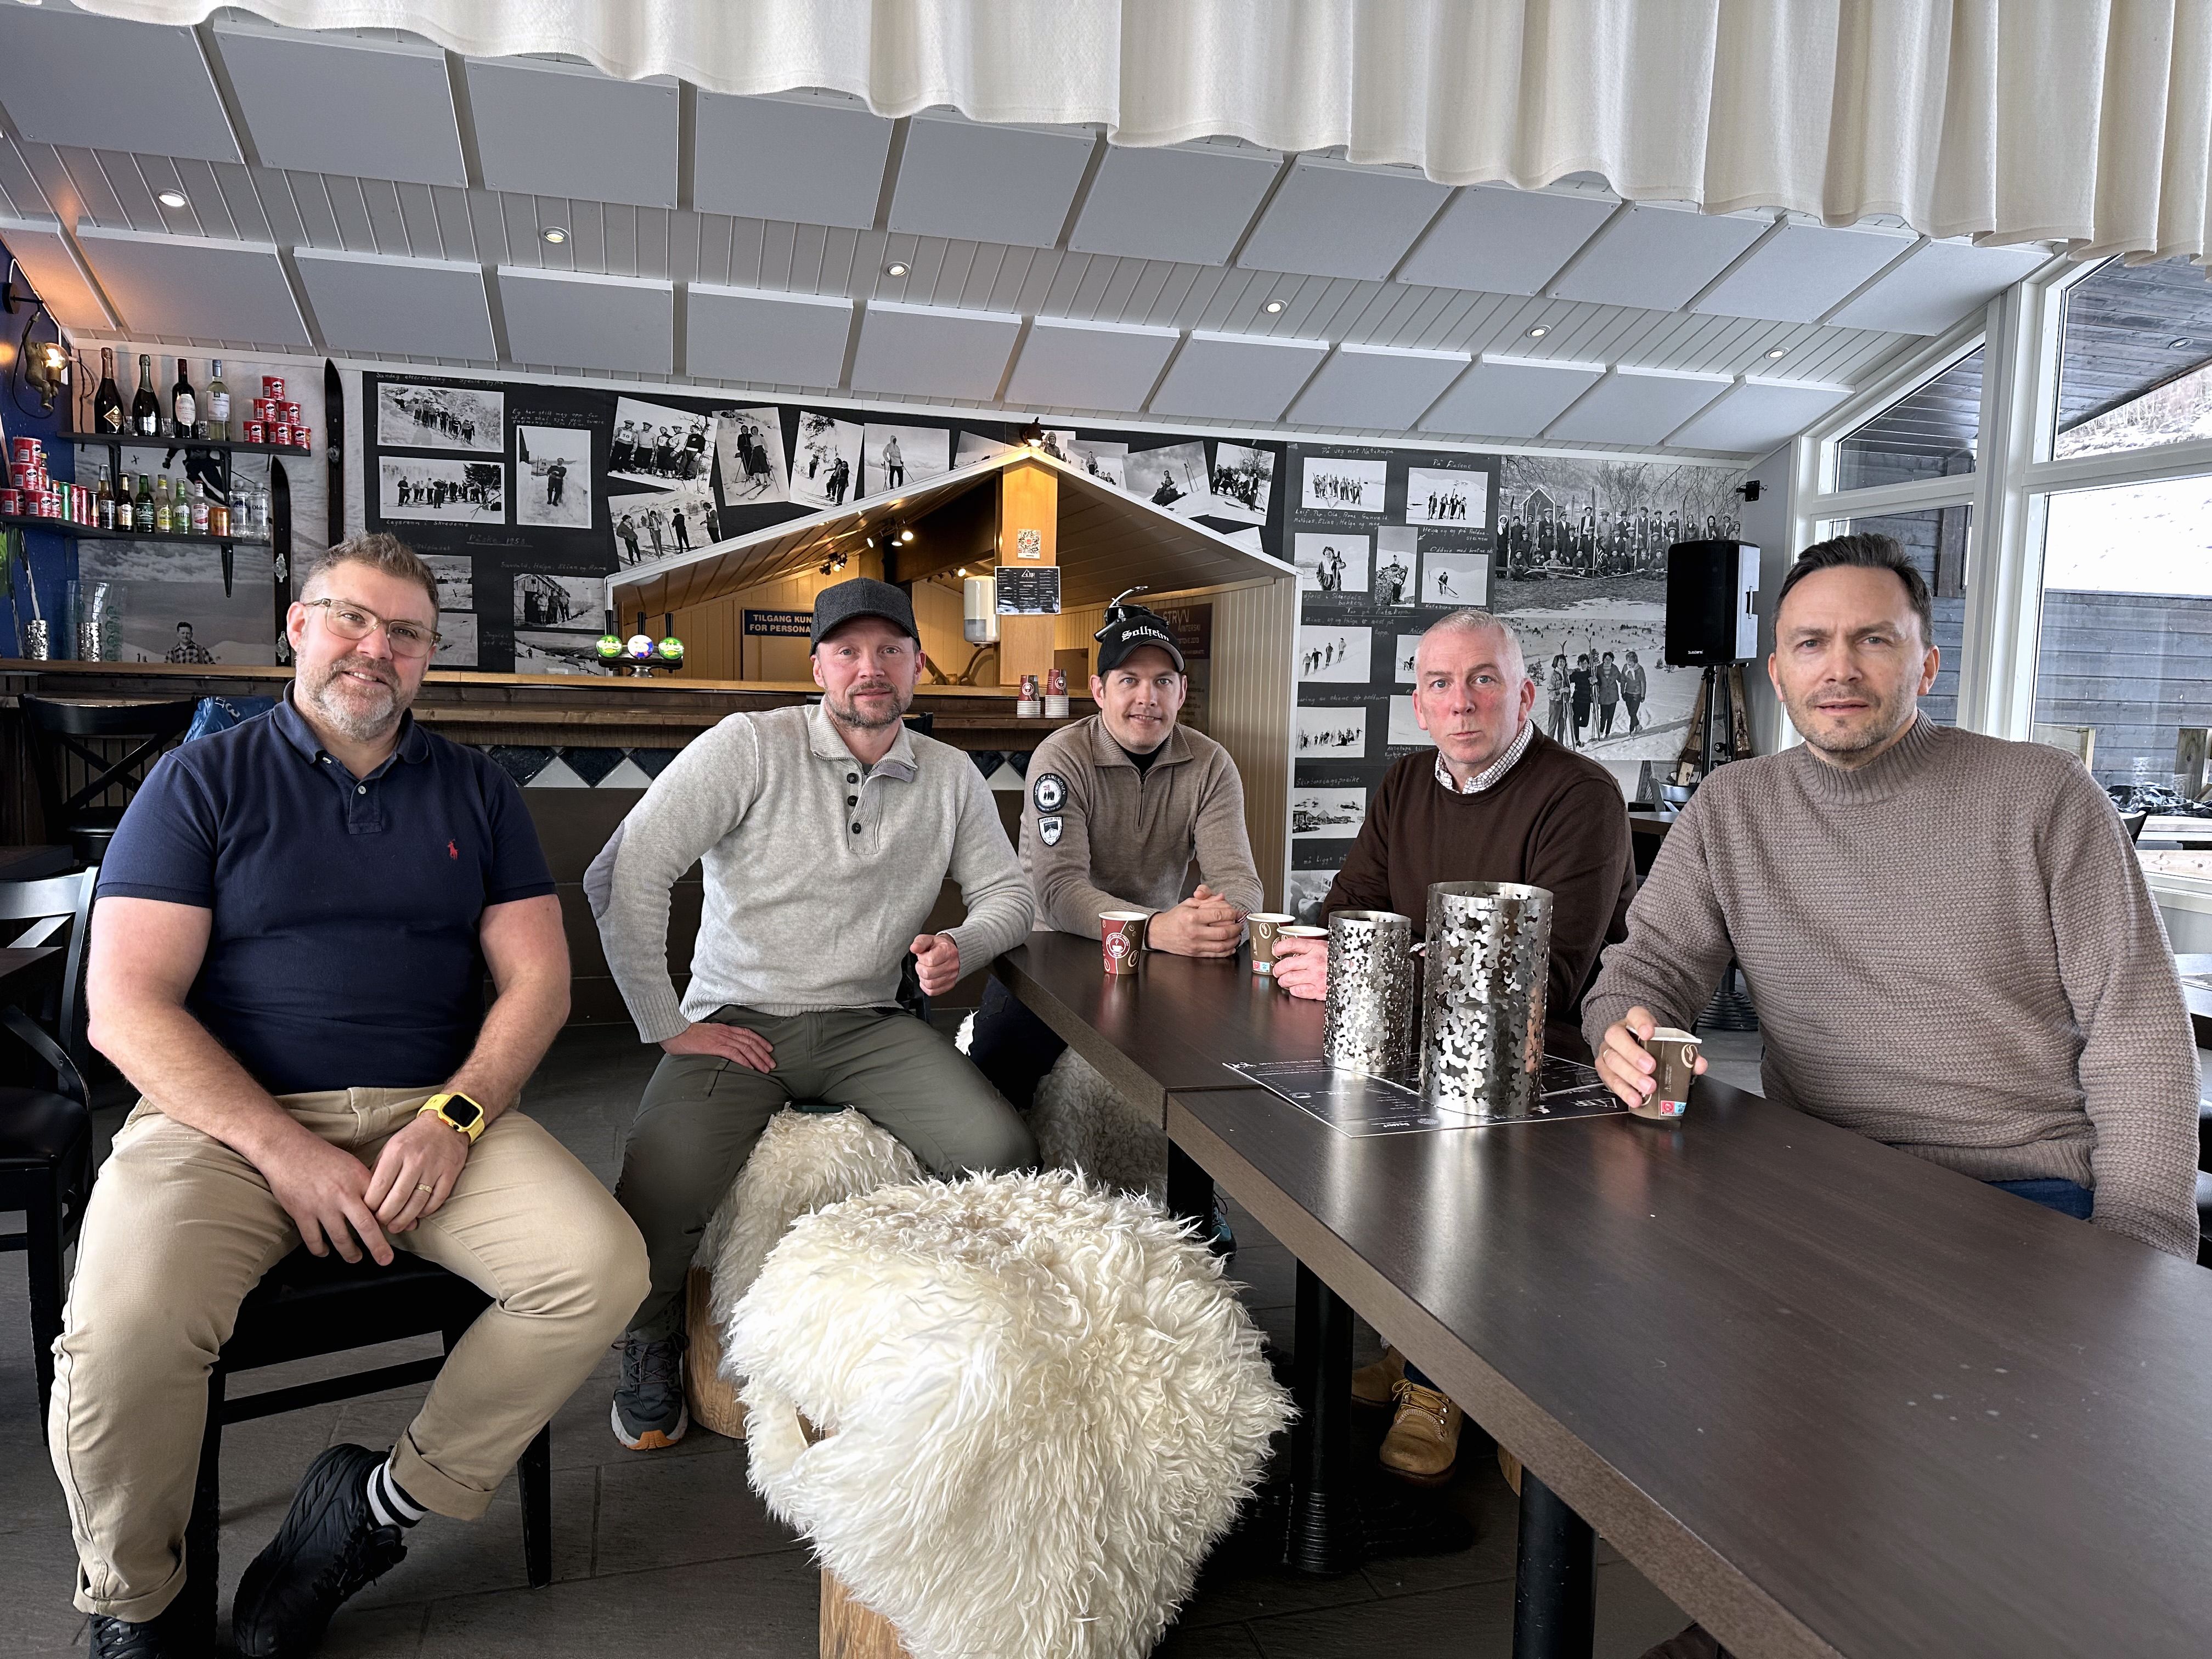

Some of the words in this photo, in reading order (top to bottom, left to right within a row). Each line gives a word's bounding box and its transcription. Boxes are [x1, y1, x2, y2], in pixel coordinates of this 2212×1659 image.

[1334, 448, 1344, 456] veg
[753, 614, 792, 623] TILGANG
[770, 624, 811, 633] PERSONA
